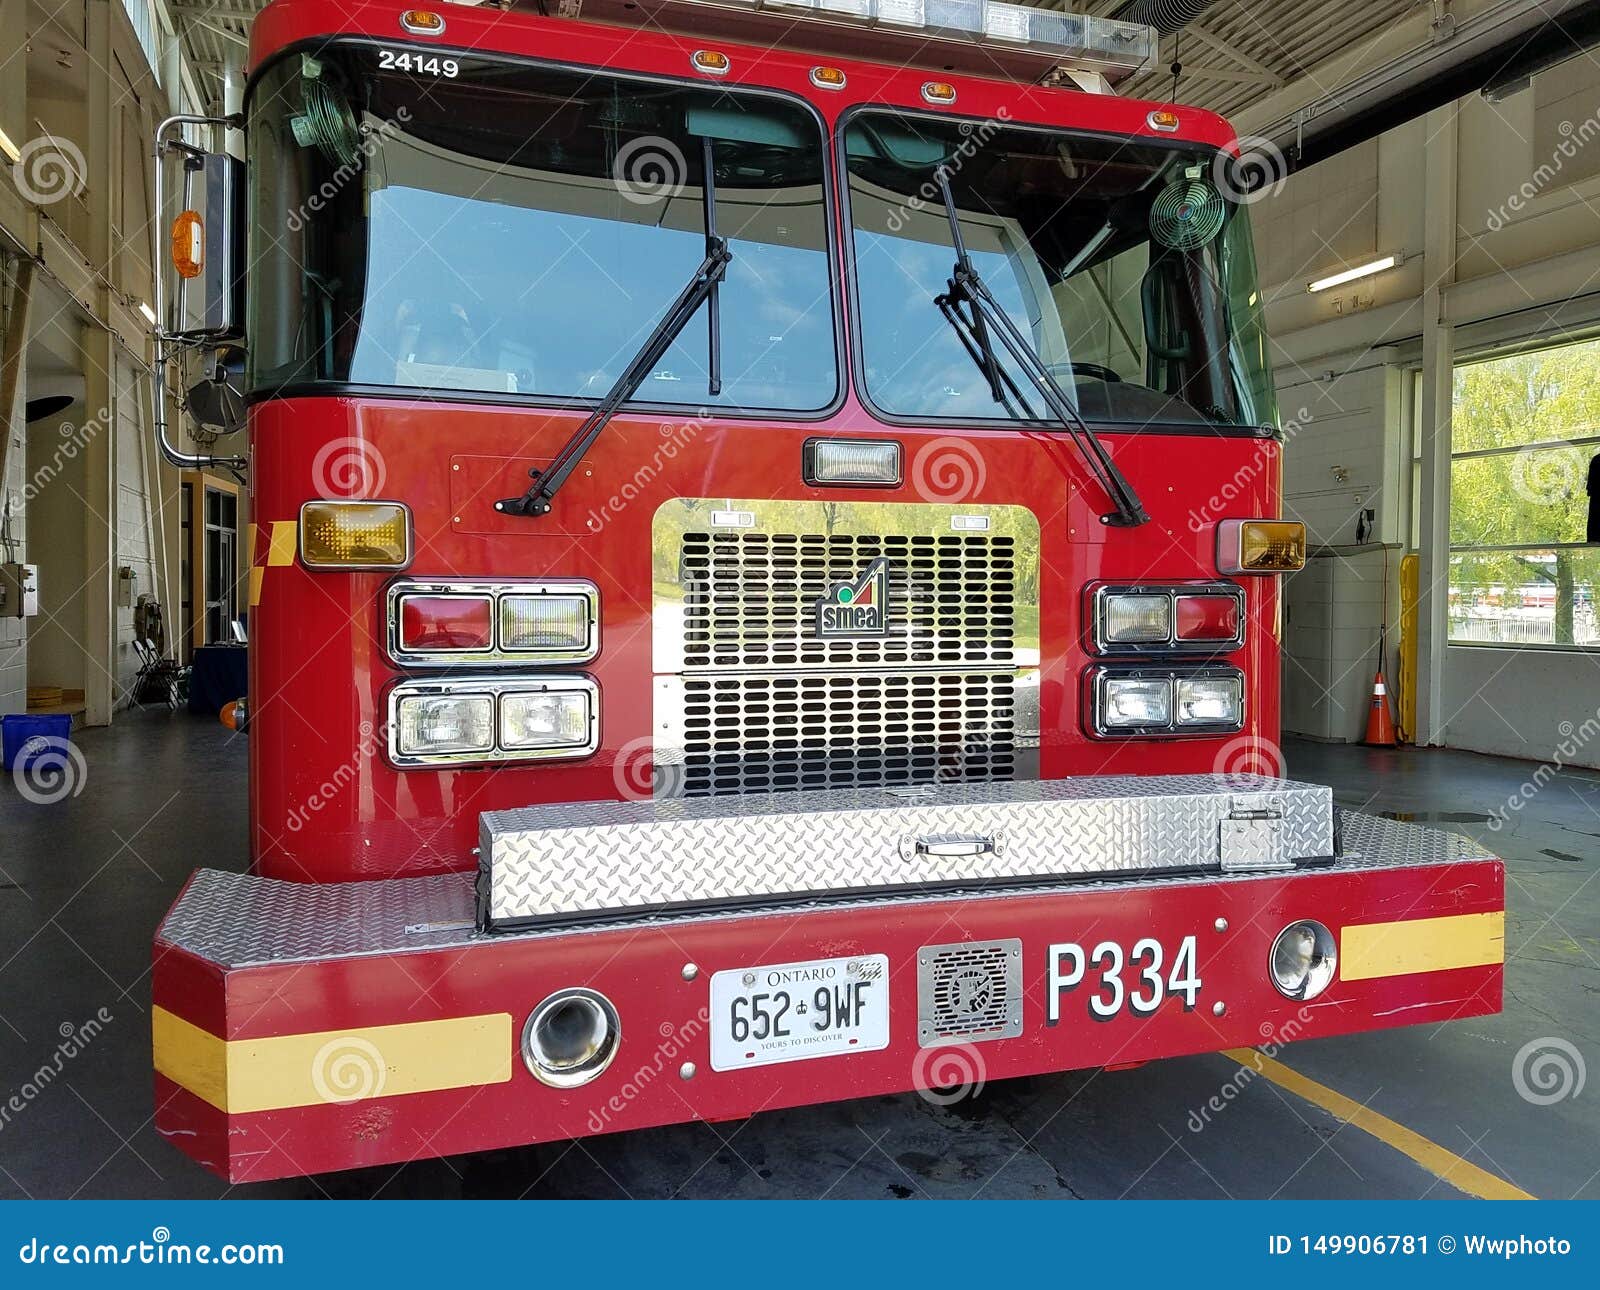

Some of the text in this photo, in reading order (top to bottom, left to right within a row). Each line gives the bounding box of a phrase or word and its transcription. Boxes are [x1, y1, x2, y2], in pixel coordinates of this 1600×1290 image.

[378, 50, 459, 78] 24149
[767, 967, 836, 987] ONTARIO
[1046, 935, 1202, 1027] P334
[730, 981, 872, 1043] 652 9WF
[761, 1032, 843, 1051] YOURS TO DISCOVER
